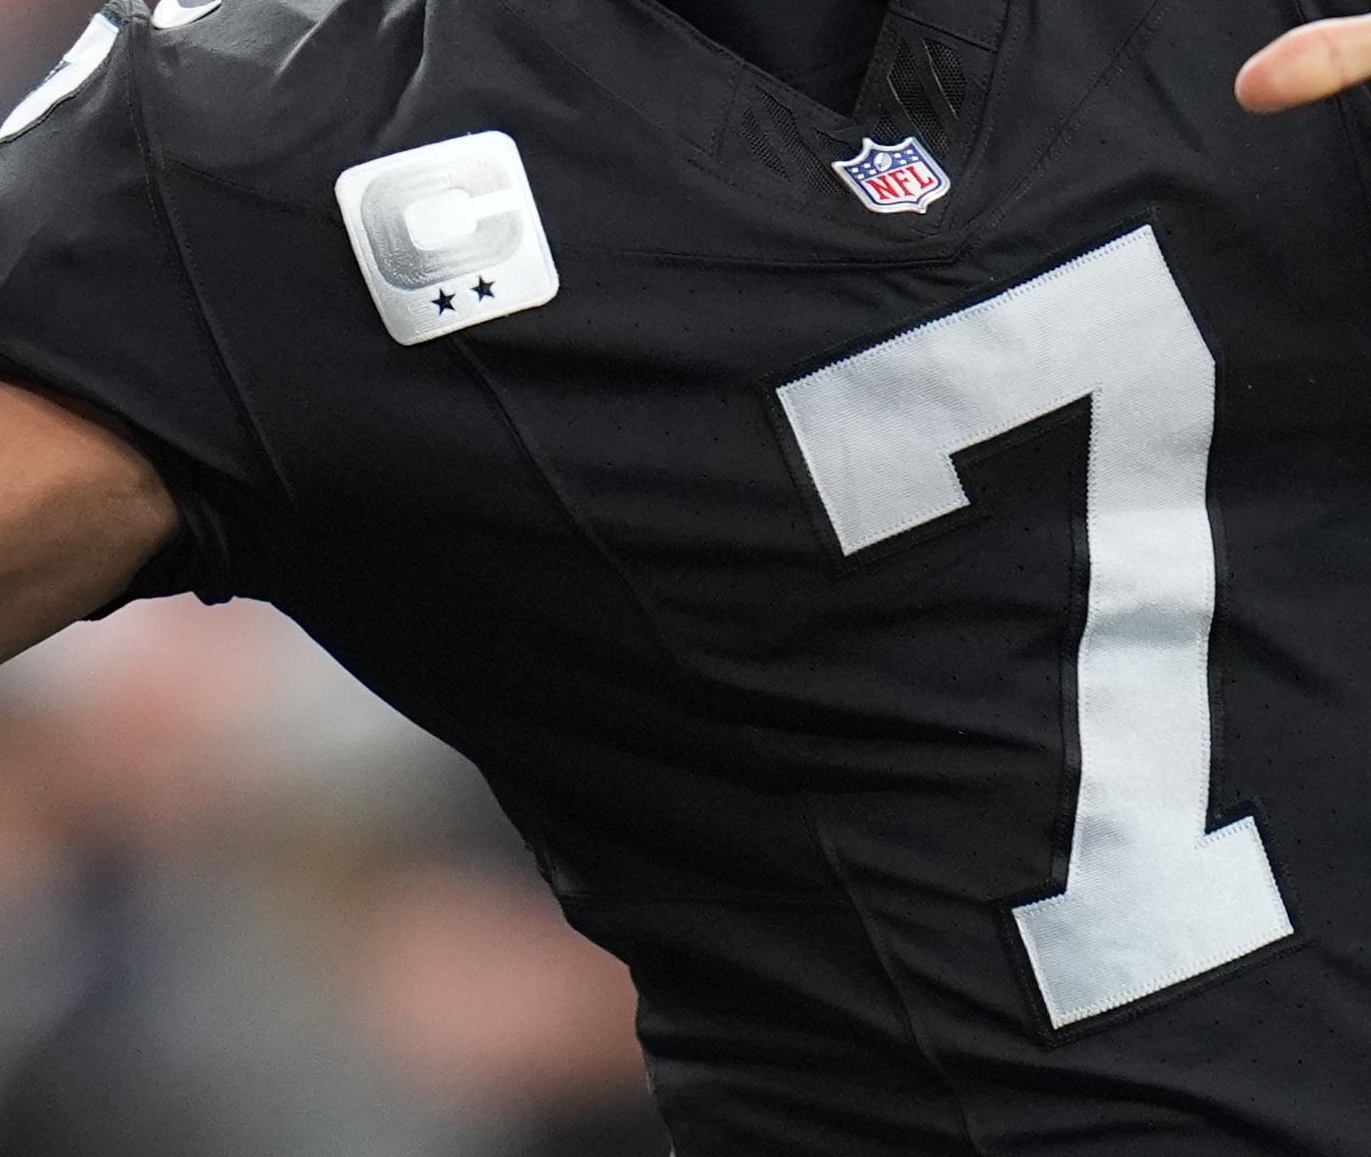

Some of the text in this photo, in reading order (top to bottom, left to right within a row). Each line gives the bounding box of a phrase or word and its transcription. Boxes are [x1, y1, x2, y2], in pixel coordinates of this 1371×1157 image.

[360, 156, 523, 291] C
[865, 165, 934, 200] NFL
[776, 225, 1294, 1029] 7
